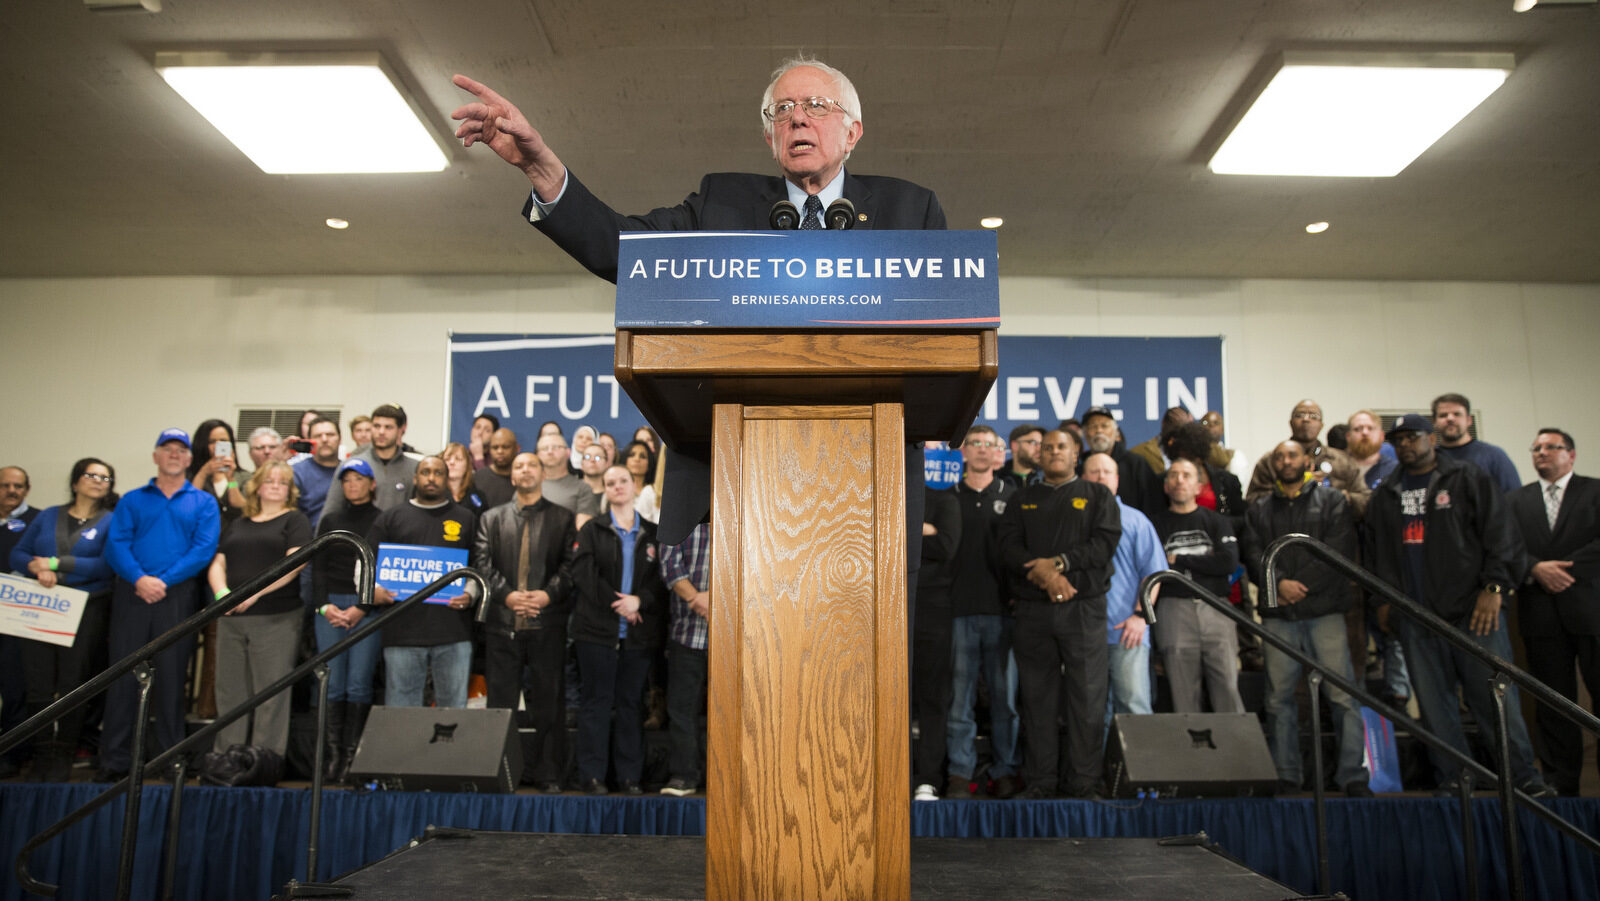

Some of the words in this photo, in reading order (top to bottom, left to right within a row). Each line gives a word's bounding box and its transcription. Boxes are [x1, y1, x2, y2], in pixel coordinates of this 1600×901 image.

[629, 258, 648, 279] A
[654, 258, 761, 279] FUTURE
[767, 257, 807, 279] TO
[815, 257, 944, 279] BELIEVE
[953, 257, 985, 279] IN
[731, 294, 882, 306] BERNIESANDERS.COM
[473, 375, 511, 418] A
[525, 375, 620, 420] FUT
[981, 376, 1124, 421] IEVE
[1145, 376, 1208, 421] IN
[944, 460, 961, 472] TO
[943, 471, 960, 483] IN
[381, 556, 391, 568] A
[393, 557, 444, 572] FUTURE
[0, 583, 71, 613] Bernie
